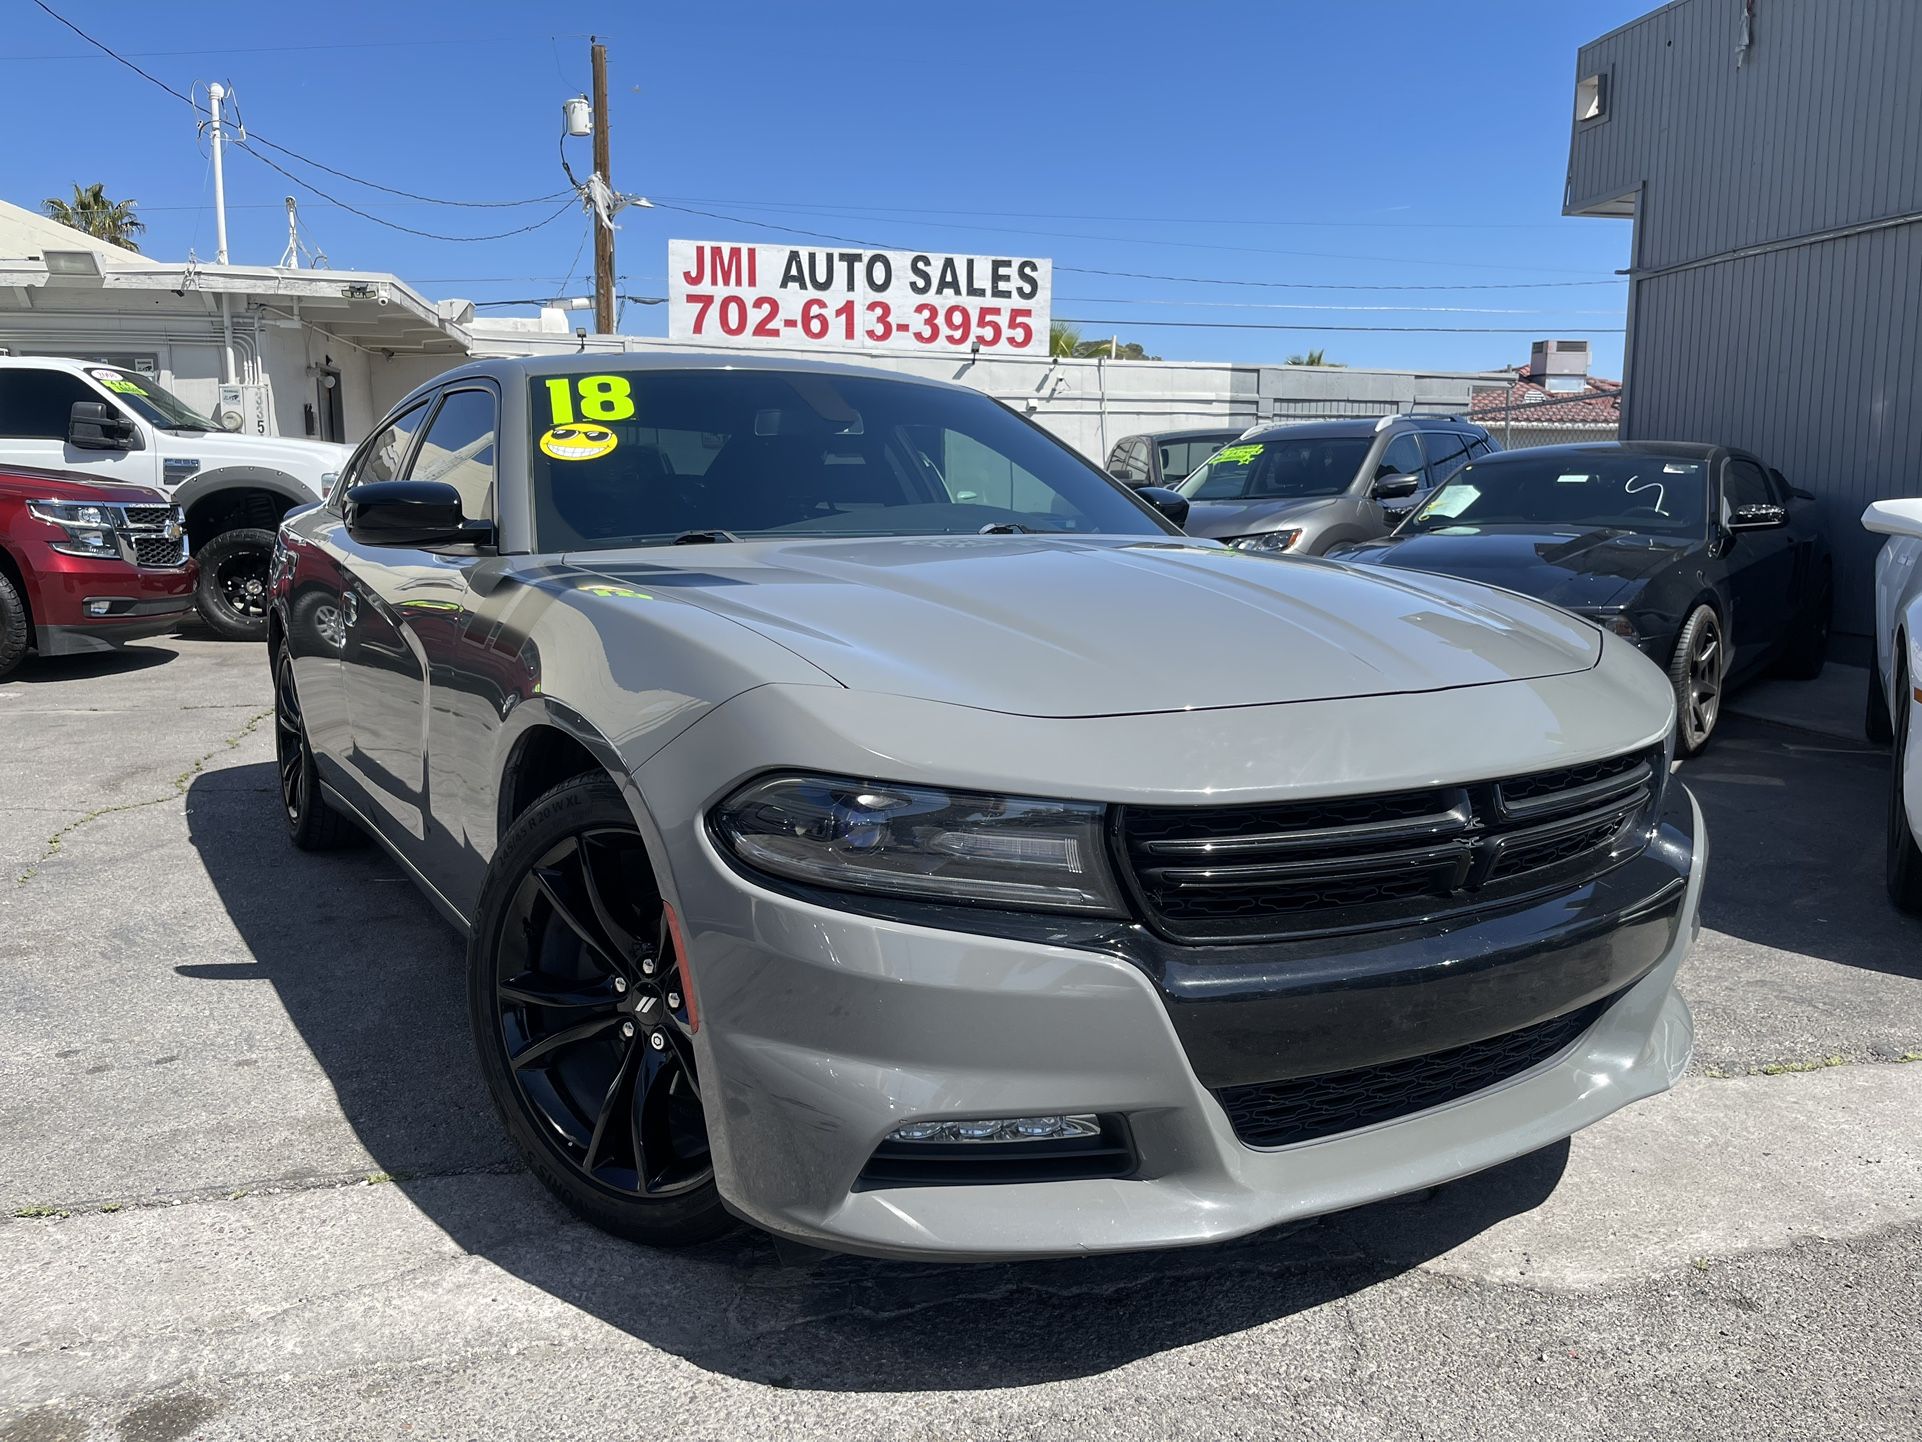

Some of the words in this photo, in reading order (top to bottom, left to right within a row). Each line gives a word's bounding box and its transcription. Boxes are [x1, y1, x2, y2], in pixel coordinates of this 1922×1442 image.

[683, 246, 757, 288] JMI
[779, 251, 893, 293] AUTO
[909, 255, 1039, 300] SALES
[685, 295, 1034, 348] 702-613-3955
[255, 391, 265, 436] 335
[545, 375, 636, 424] 18
